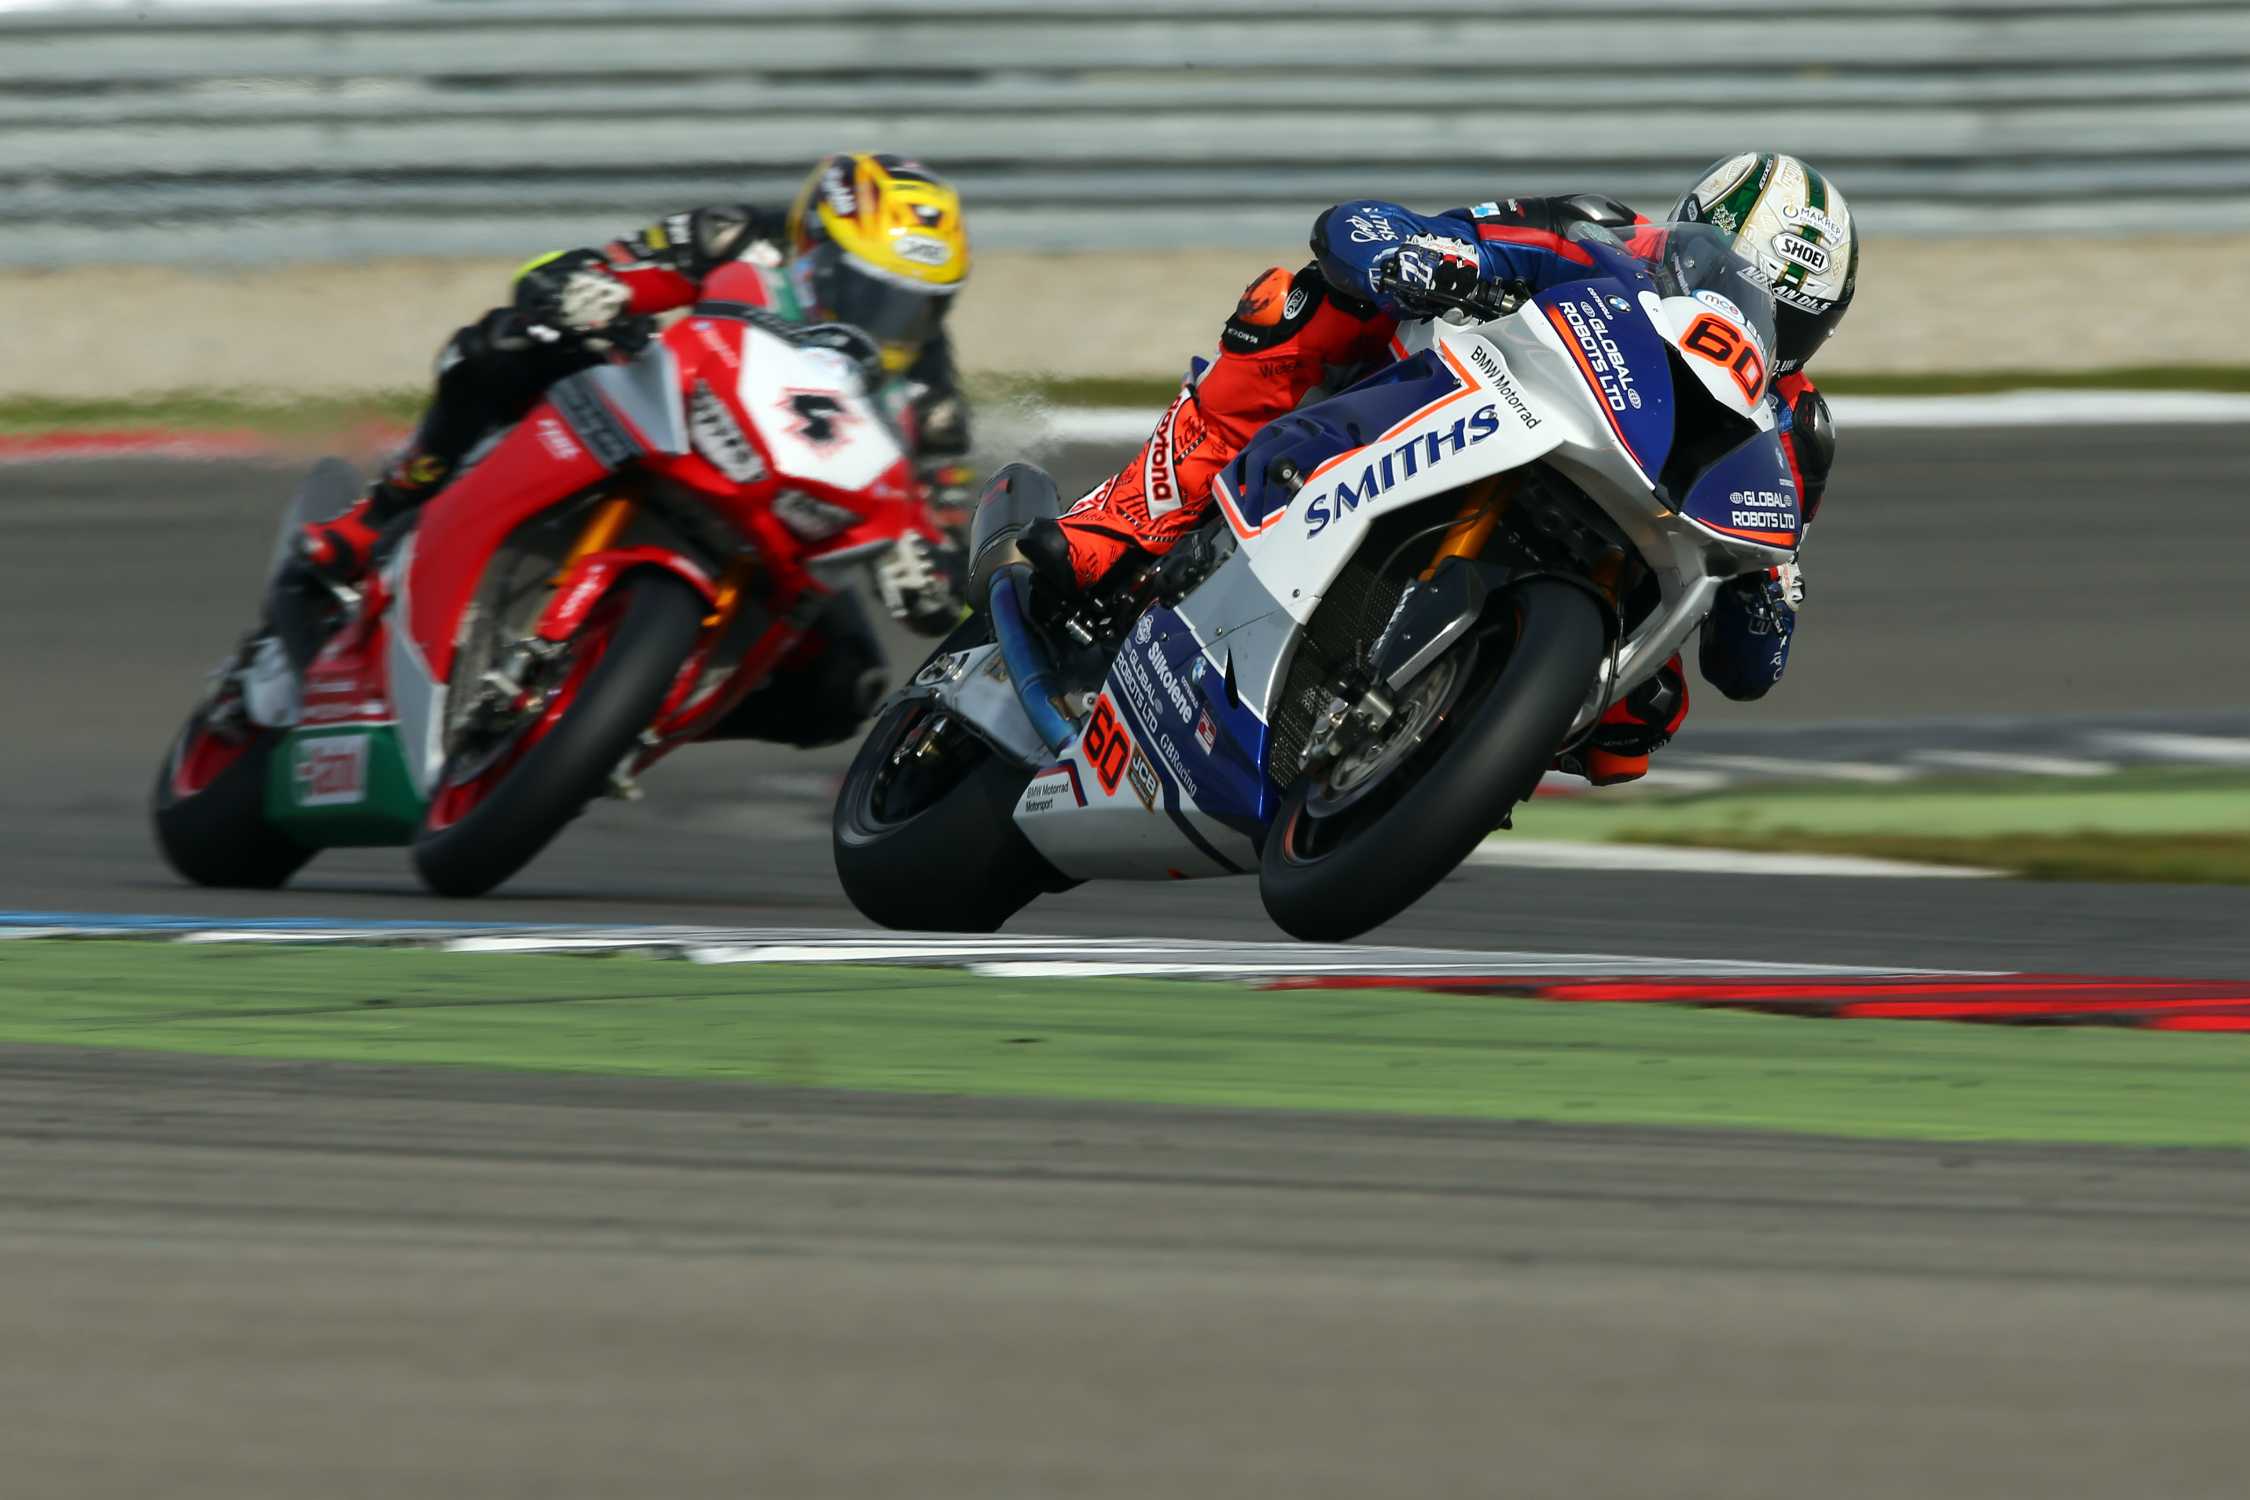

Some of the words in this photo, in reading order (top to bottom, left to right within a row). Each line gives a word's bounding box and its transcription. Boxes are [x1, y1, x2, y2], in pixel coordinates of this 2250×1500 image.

[1781, 238, 1825, 269] SHOEI
[1705, 294, 1739, 315] mce
[1559, 301, 1610, 373] ROBOTS
[1599, 375, 1627, 411] LTD
[1588, 318, 1633, 391] GLOBAL
[1683, 315, 1764, 403] 60
[1470, 345, 1502, 379] BMW
[1492, 376, 1542, 430] Motorrad
[1305, 403, 1500, 540] SMITHS
[1743, 490, 1786, 508] GLOBAL
[1731, 511, 1778, 528] ROBOTS
[1779, 513, 1795, 529] LTD
[1116, 651, 1144, 708] ROBOTS
[1142, 702, 1158, 733] LTD
[1129, 649, 1156, 706] GLOBAL
[1148, 641, 1193, 724] Silkolene
[1084, 697, 1130, 793] 60
[1132, 756, 1158, 796] JCB
[1160, 733, 1197, 797] GBRacing
[1026, 798, 1053, 813] Motorsport
[1042, 780, 1069, 796] Motorrad
